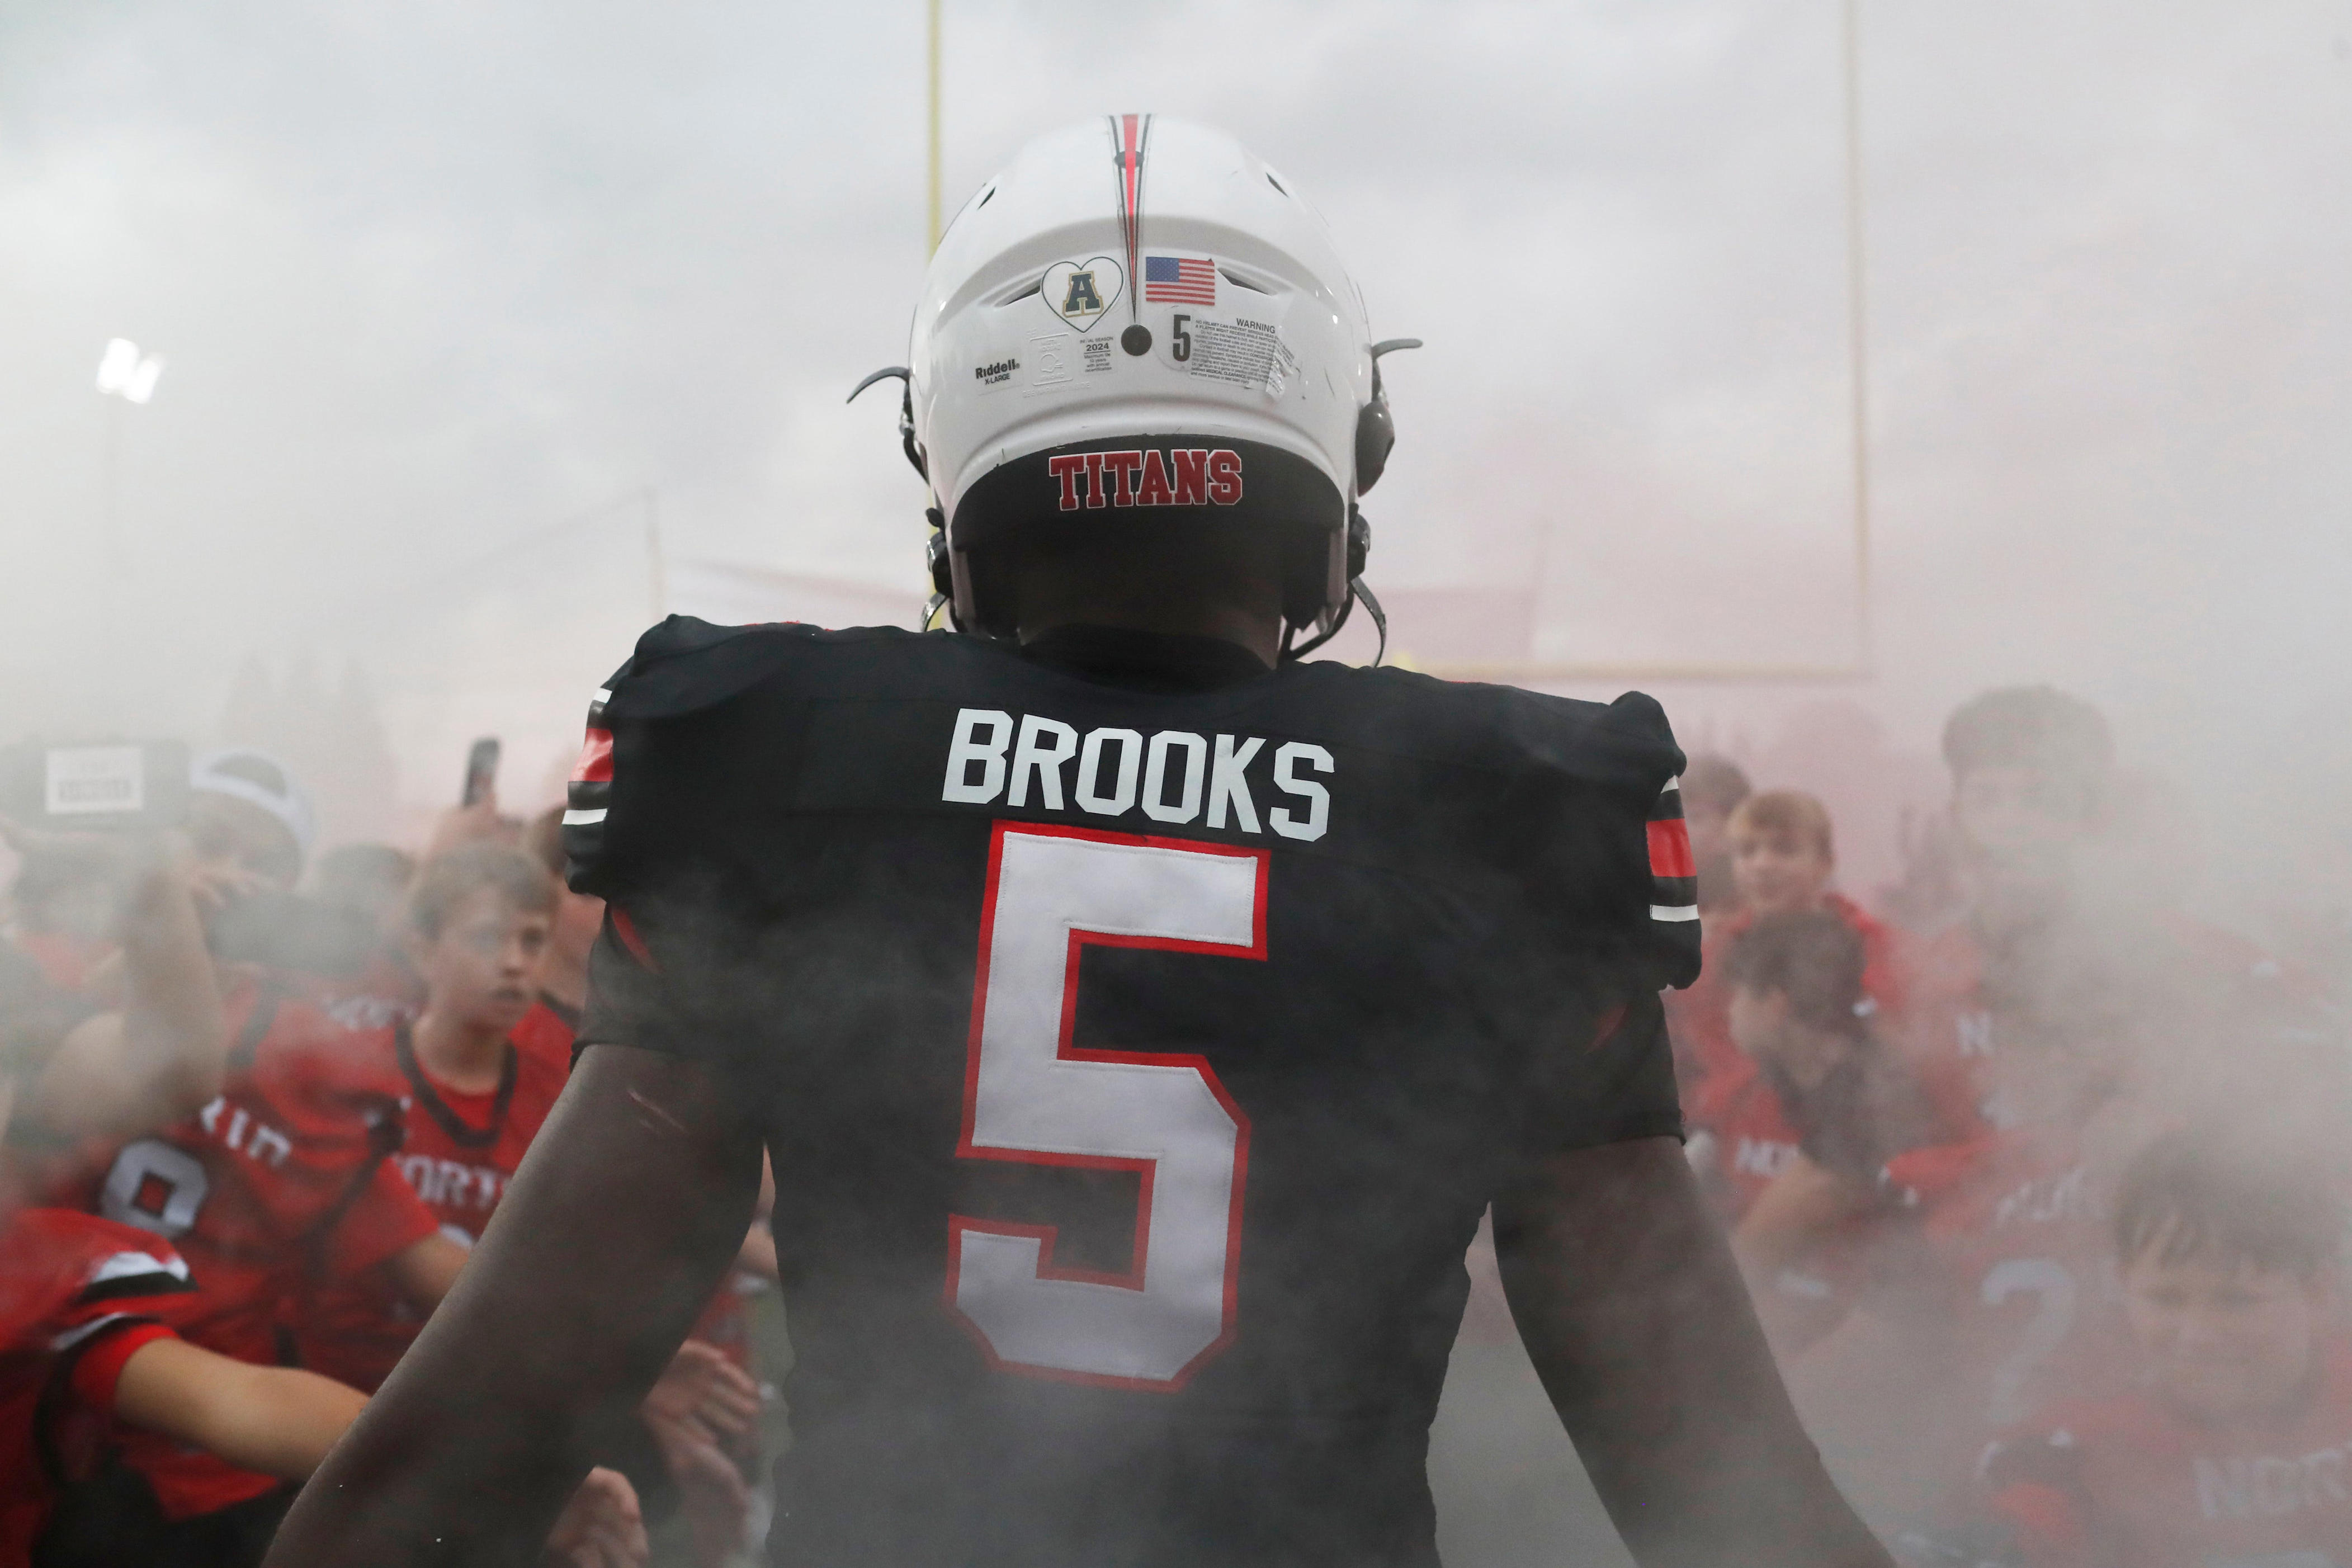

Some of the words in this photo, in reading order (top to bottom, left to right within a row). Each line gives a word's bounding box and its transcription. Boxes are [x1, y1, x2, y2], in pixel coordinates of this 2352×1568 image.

[1062, 271, 1103, 318] A
[1086, 343, 1109, 352] 2024
[1173, 314, 1191, 362] 5
[1236, 318, 1276, 334] WARNING
[975, 358, 1016, 379] Riddell
[984, 372, 1011, 385] X-LARGE
[1049, 449, 1243, 511] TITANS
[942, 708, 1335, 842] BROOKS
[942, 819, 1271, 1394] 5
